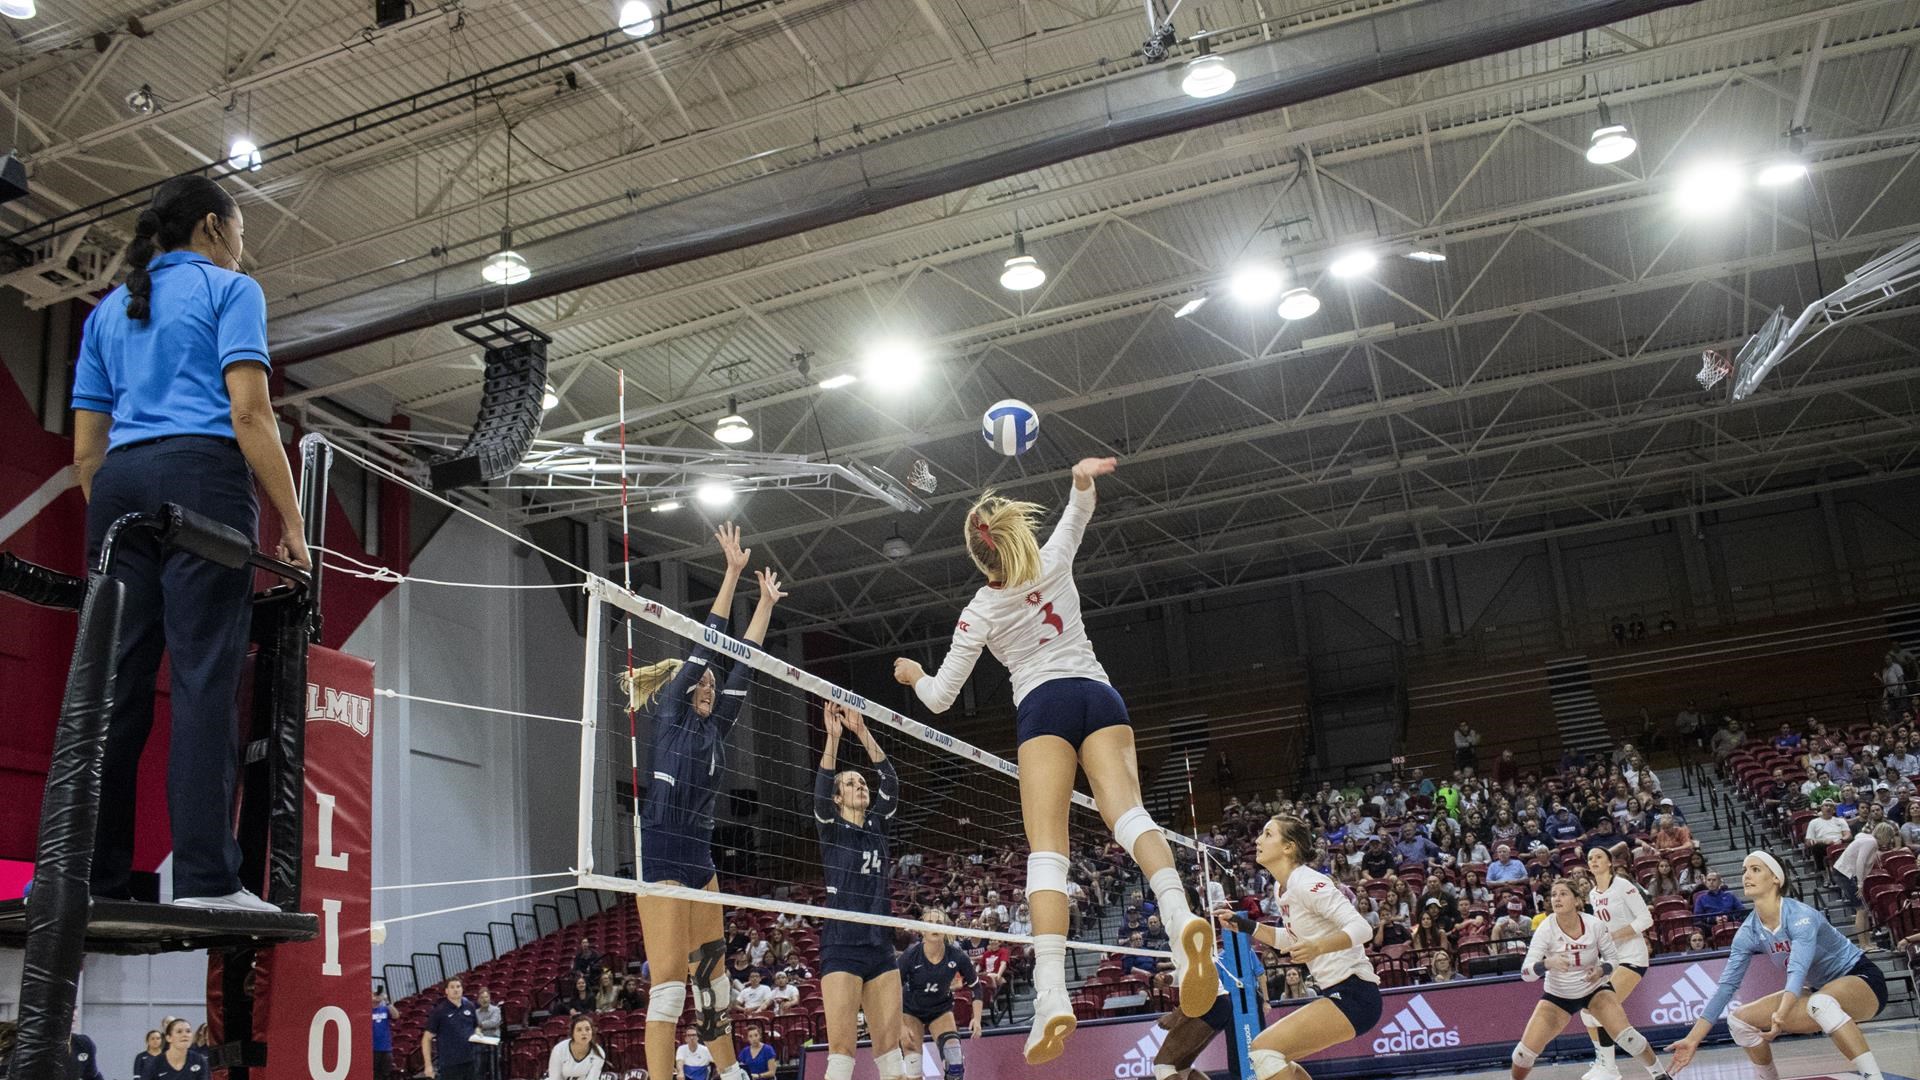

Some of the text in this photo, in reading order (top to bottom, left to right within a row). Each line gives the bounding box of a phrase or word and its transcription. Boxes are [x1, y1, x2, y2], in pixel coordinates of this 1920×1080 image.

[644, 602, 663, 619] LMU
[704, 628, 752, 660] GO LIONS
[306, 683, 371, 737] LMU
[831, 686, 867, 710] GO LIONS
[1391, 755, 1406, 765] 103
[860, 849, 881, 874] 24
[1596, 907, 1611, 922] 10
[1571, 951, 1581, 966] 1
[1372, 1029, 1461, 1054] adidas
